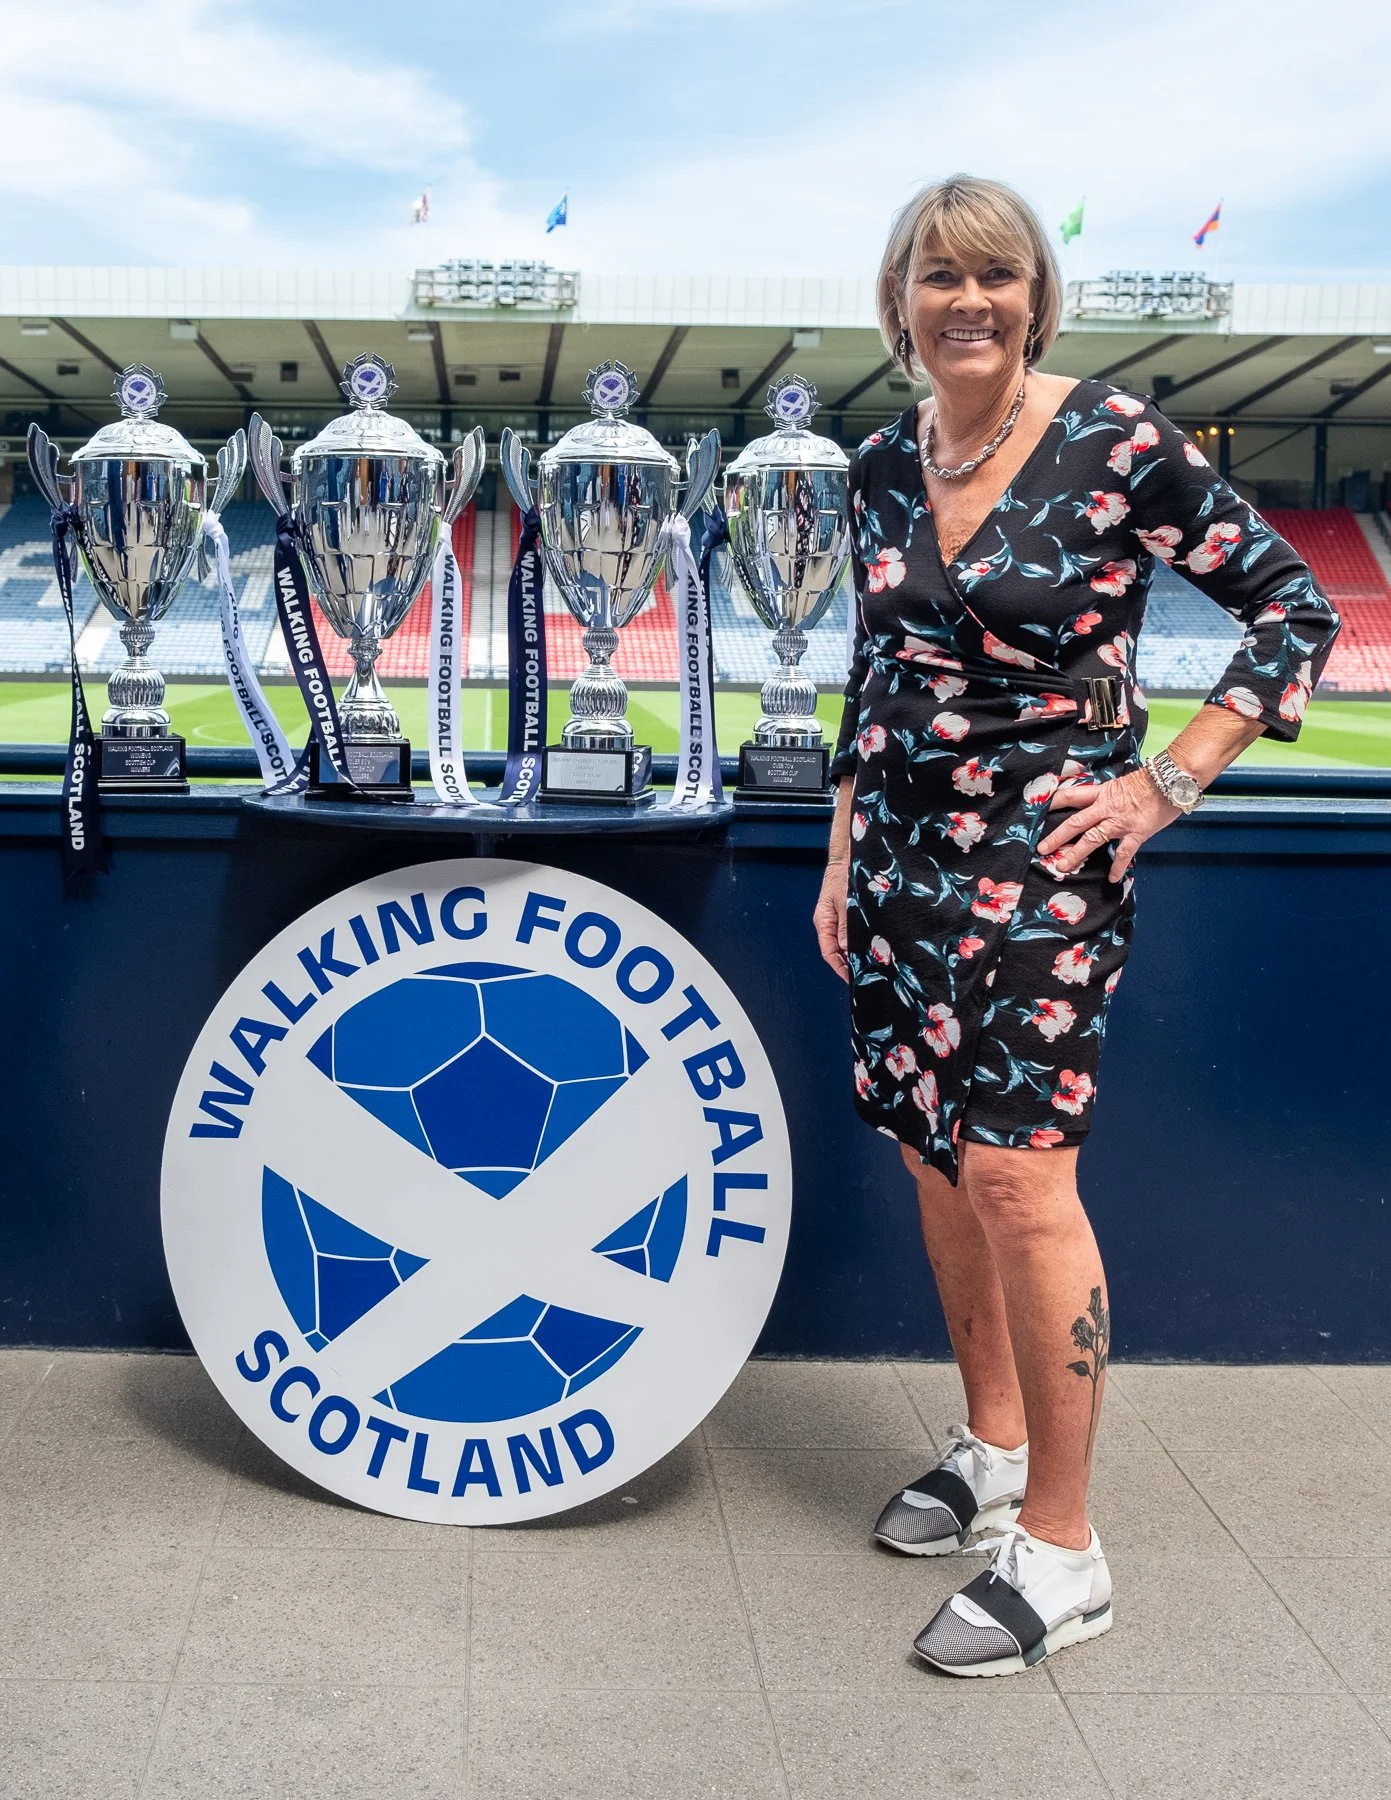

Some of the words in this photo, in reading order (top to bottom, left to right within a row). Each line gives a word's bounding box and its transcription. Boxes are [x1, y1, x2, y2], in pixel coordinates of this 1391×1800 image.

[440, 555, 455, 647] WALKING
[520, 551, 538, 643] WALKING
[277, 566, 314, 664] WALKING
[304, 667, 343, 772] FOOTBALL
[437, 654, 453, 757] FOOTBALL
[524, 649, 539, 752] FOOTBALL
[687, 633, 702, 736] FOOTBALL
[68, 743, 85, 850] SCOTLAND
[188, 886, 489, 1140] WALKING
[515, 891, 769, 1258] FOOTBALL
[235, 1330, 616, 1498] SCOTLAND
